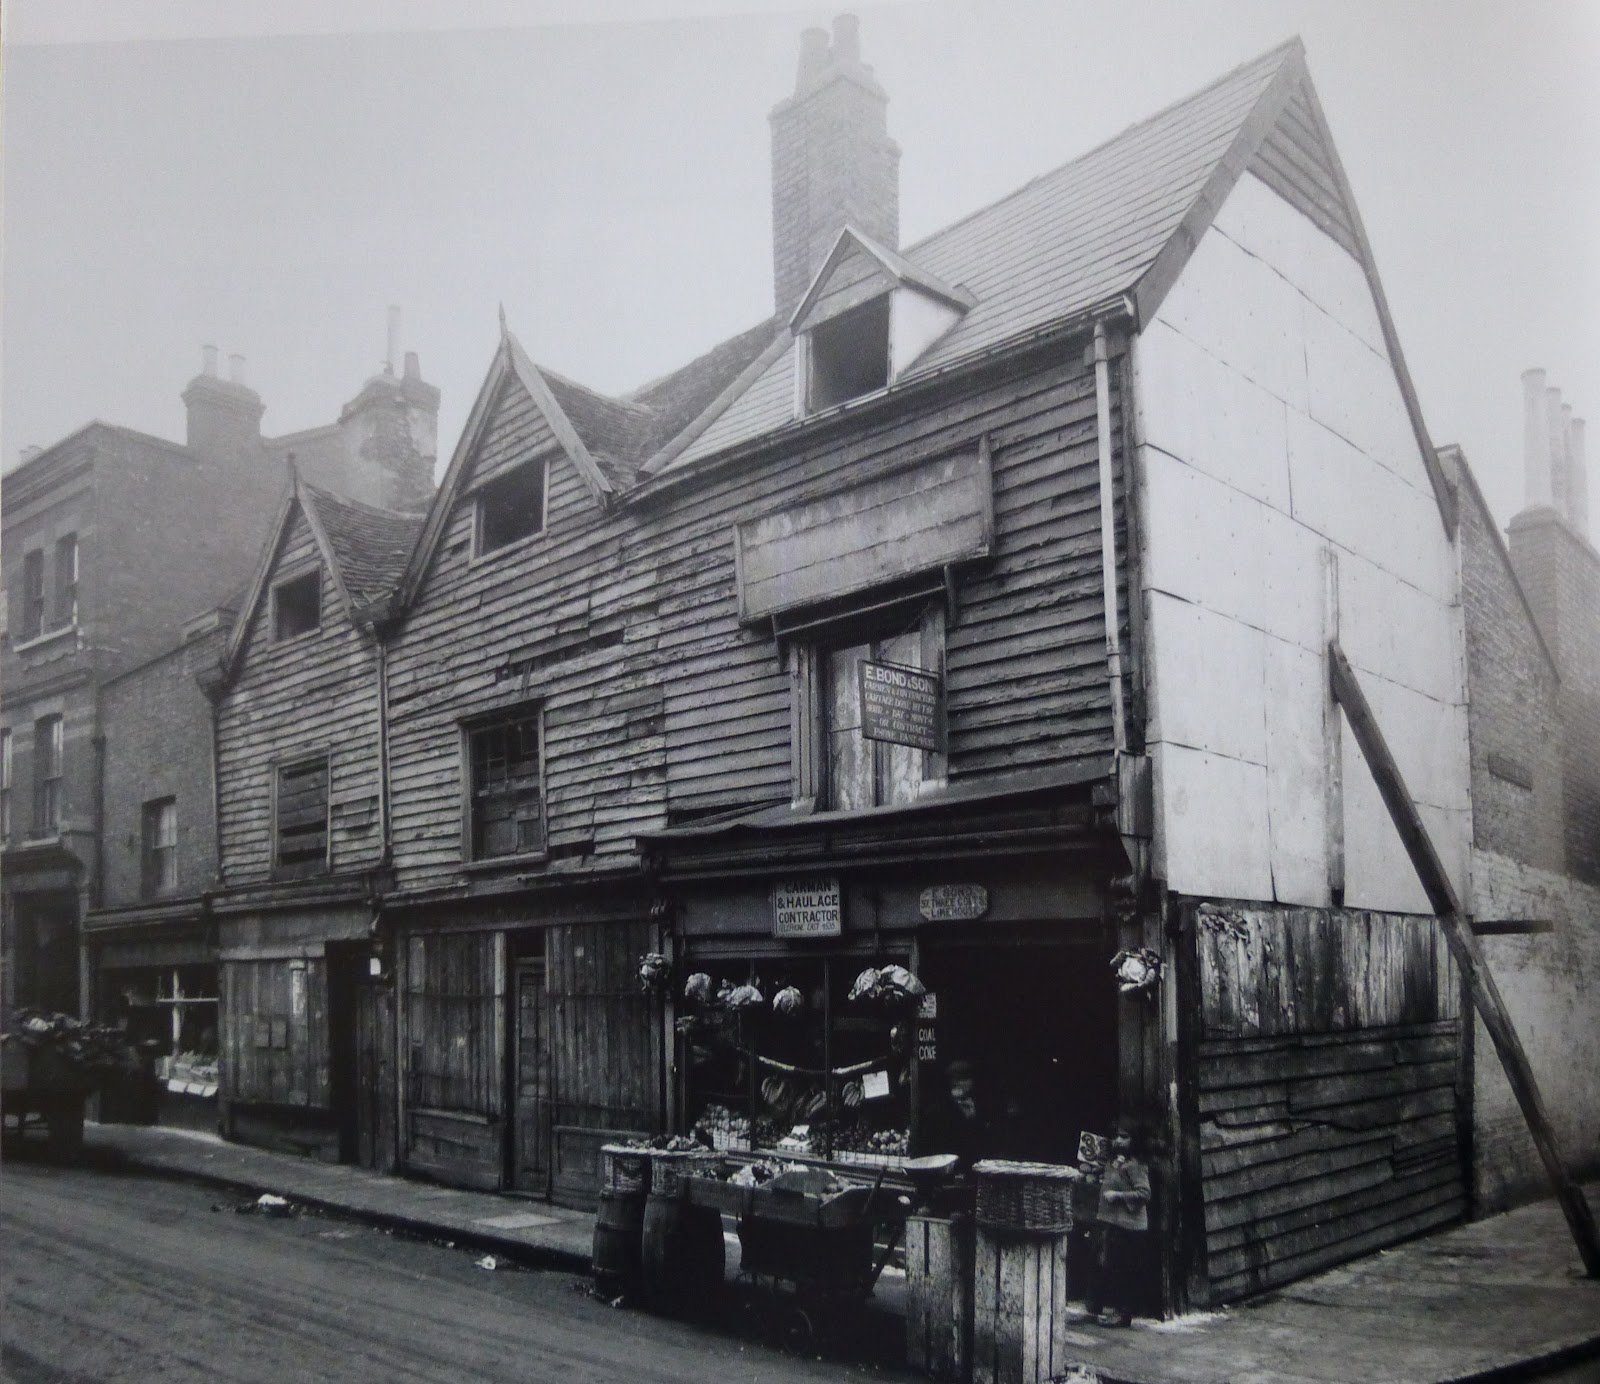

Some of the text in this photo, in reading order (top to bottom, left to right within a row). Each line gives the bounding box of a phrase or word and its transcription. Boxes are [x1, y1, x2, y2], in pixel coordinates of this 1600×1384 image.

[778, 910, 838, 924] CONTRACTOR
[918, 1028, 936, 1041] COAL
[918, 1046, 936, 1060] COKE
